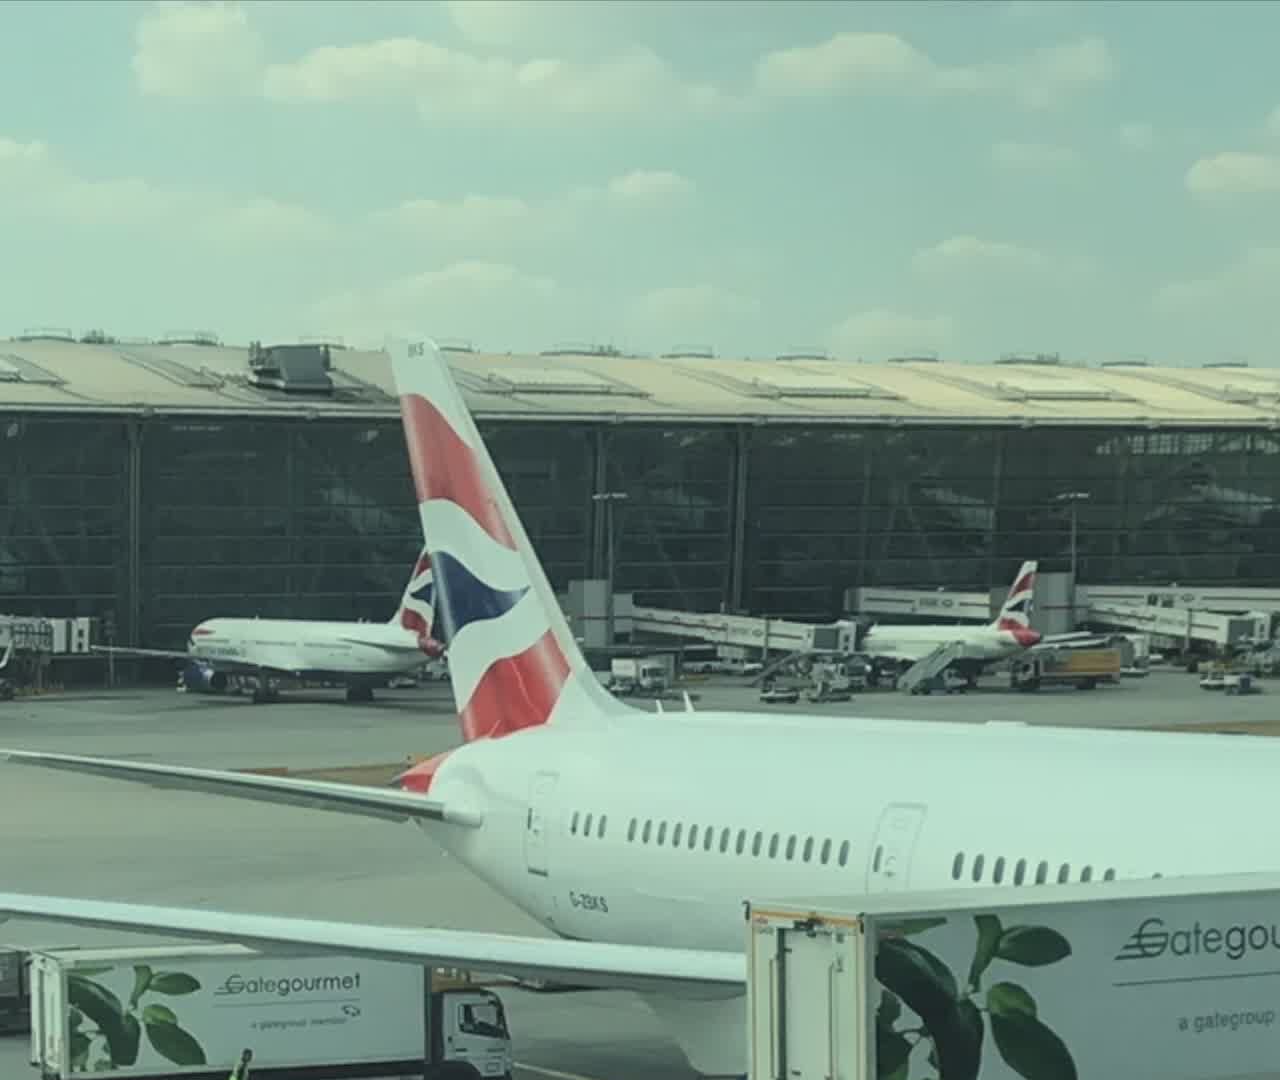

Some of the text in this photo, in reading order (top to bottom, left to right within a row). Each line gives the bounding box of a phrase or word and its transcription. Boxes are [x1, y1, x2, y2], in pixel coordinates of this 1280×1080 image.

[213, 973, 361, 997] Gategourmet
[1178, 1016, 1189, 1031] a
[1193, 1010, 1274, 1033] gategroup
